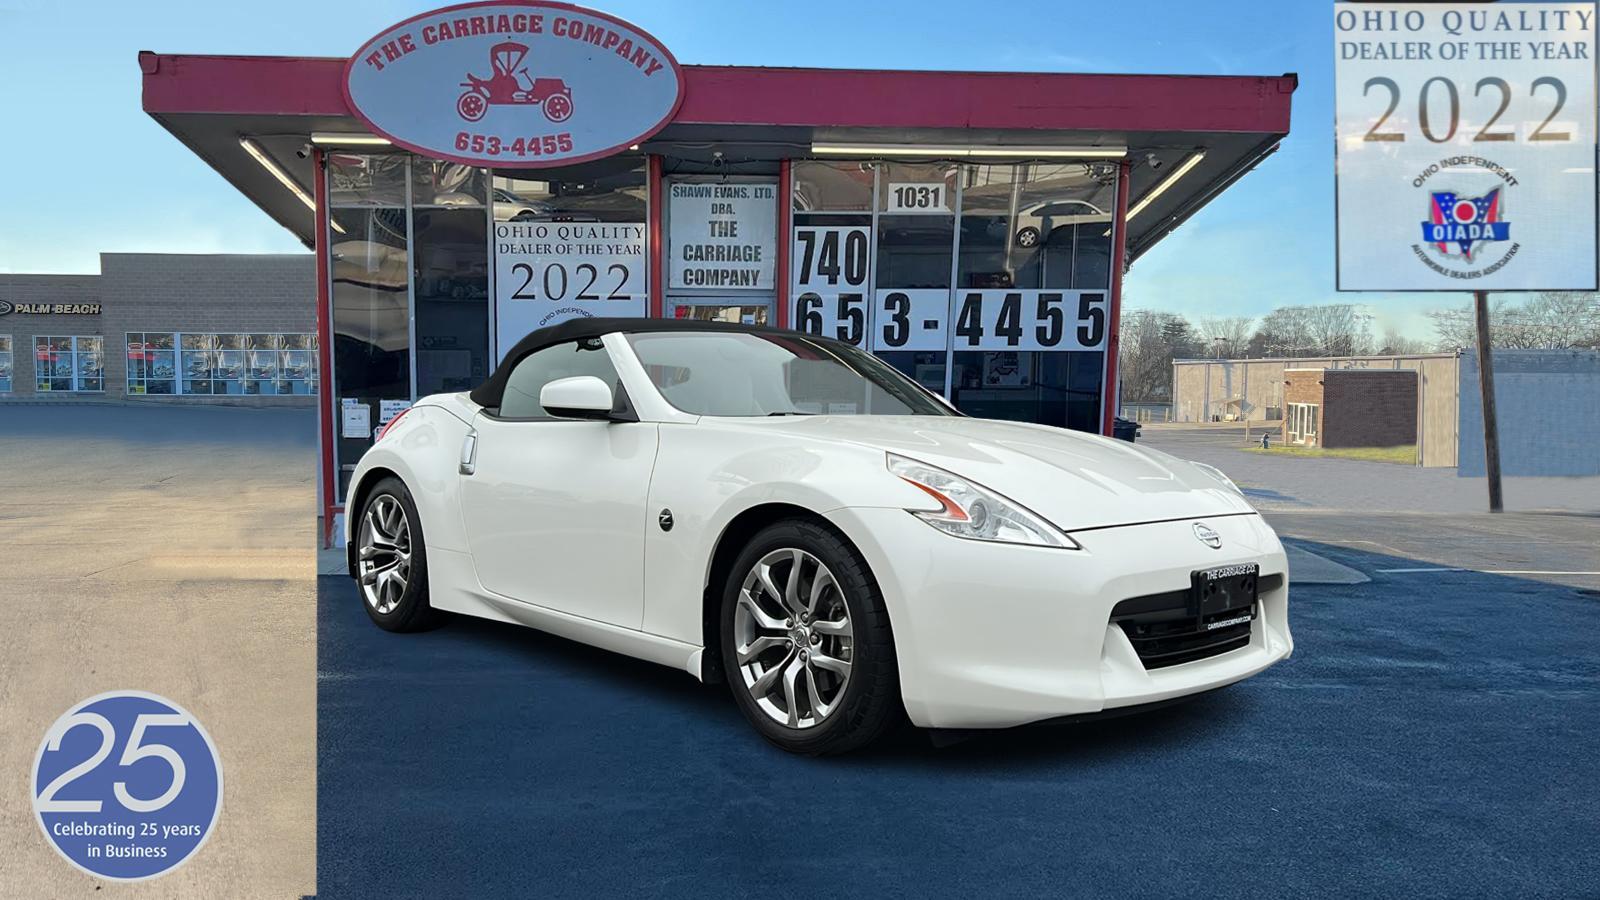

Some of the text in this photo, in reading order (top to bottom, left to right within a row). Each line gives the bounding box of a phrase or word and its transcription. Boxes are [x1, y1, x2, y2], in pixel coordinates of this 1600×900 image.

[1336, 10, 1593, 36] OHIO QUALITY
[365, 14, 665, 77] THE CARRIAGE COMPANY
[1340, 41, 1589, 60] DEALER OF THE YEAR
[1362, 76, 1571, 143] 2022
[454, 132, 574, 157] 653-4455
[1412, 155, 1519, 188] OHIO INDEPENDENT
[672, 186, 713, 199] SHAWN
[754, 186, 775, 199] LTD.
[894, 186, 941, 208] 1031
[711, 203, 736, 215] DBA.
[496, 225, 645, 241] OHIO QUALITY
[708, 220, 738, 238] THE
[1432, 224, 1495, 241] OIADA
[499, 244, 642, 255] DEALER OF THE YEAR
[682, 244, 763, 263] CARRIAGE
[797, 230, 868, 285] 740
[1411, 242, 1520, 280] AUTOMOBILE DEALERS ASSOCIATION
[510, 262, 632, 301] 2022
[683, 268, 761, 287] COMPANY
[14, 304, 100, 314] PALM BEACH
[1207, 570, 1218, 580] THE
